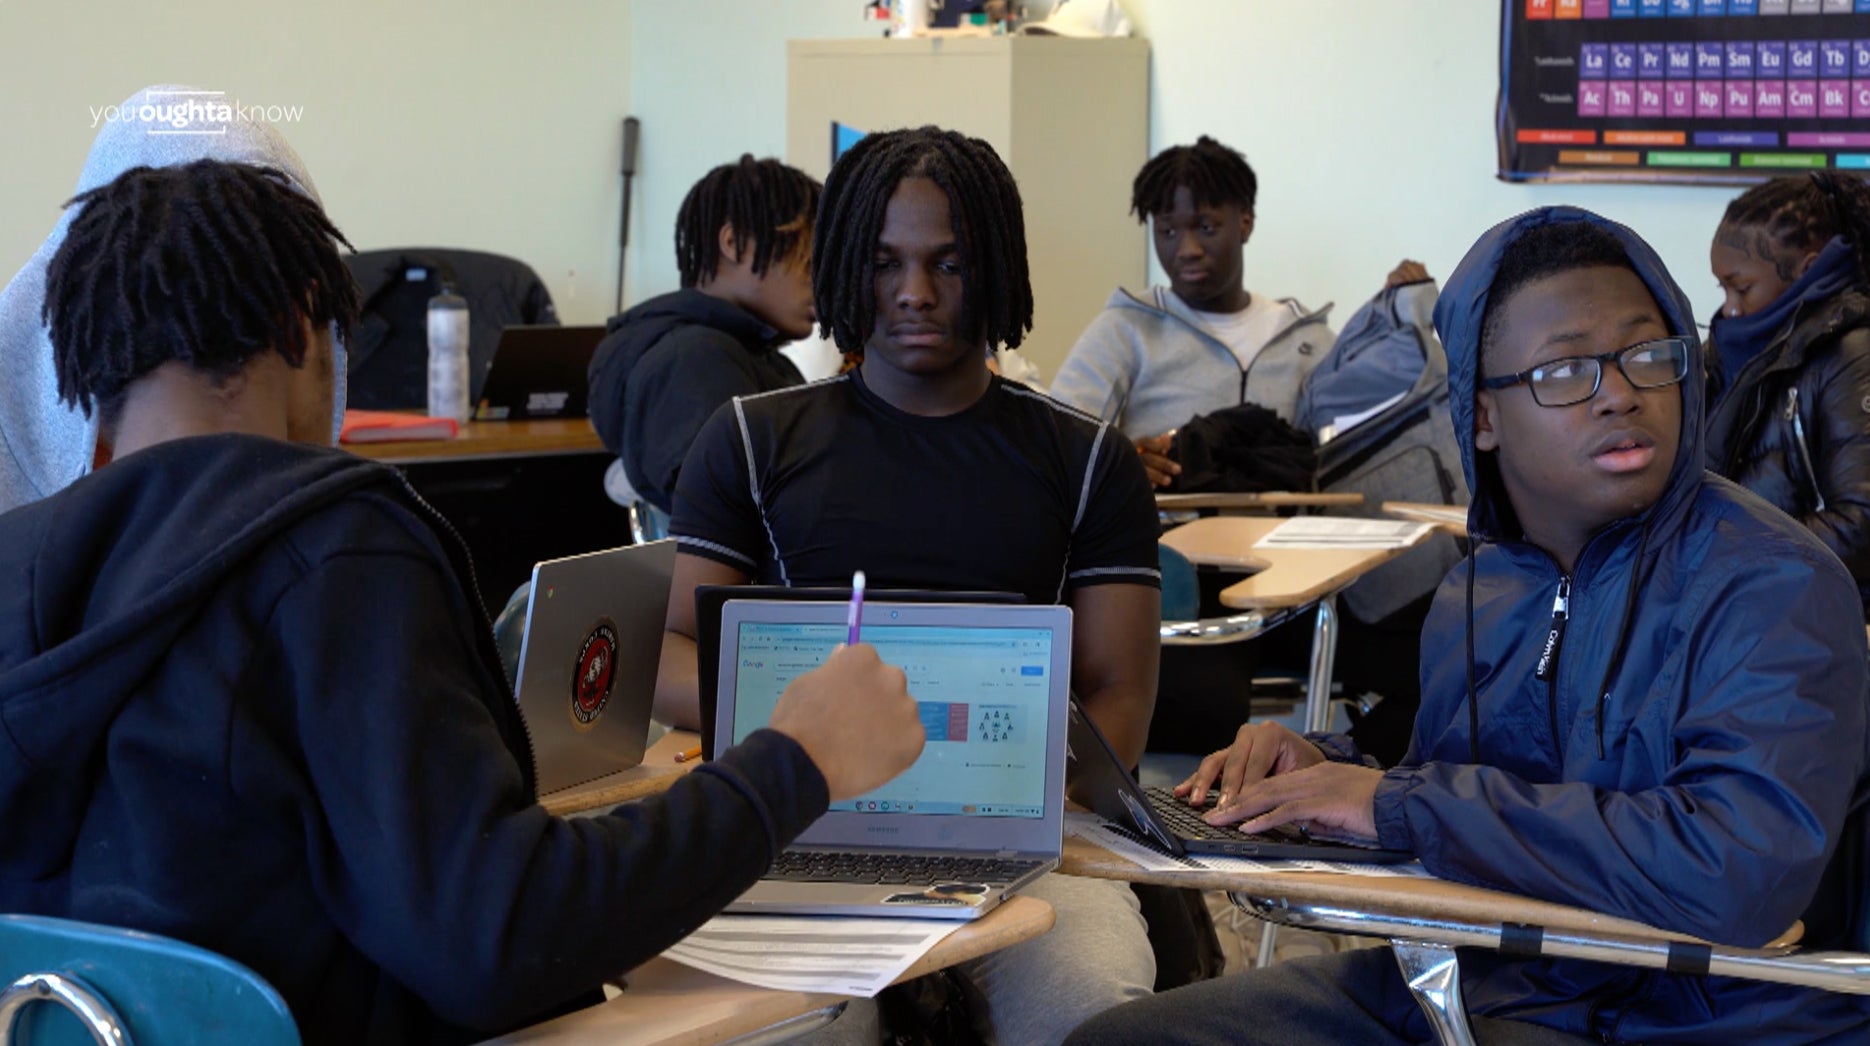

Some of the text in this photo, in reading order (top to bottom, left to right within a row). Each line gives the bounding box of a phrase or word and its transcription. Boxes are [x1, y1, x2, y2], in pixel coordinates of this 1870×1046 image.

[1585, 53, 1603, 68] La
[1614, 52, 1632, 68] Ce
[1644, 52, 1659, 68] Pr
[1670, 51, 1689, 68] Nd
[1698, 52, 1720, 67] Pm
[1729, 52, 1751, 67] Sm
[1762, 51, 1780, 67] Eu
[1792, 50, 1813, 67] Gd
[1826, 50, 1845, 67] Tb
[1583, 91, 1600, 105] Ac
[1614, 90, 1631, 105] Th
[1642, 91, 1659, 106] Pa
[1674, 91, 1685, 106] U
[1699, 91, 1719, 109] Np
[1730, 91, 1748, 106] Pu
[1758, 91, 1781, 106] Am
[1790, 90, 1813, 106] Cm
[1825, 90, 1844, 106] Bk
